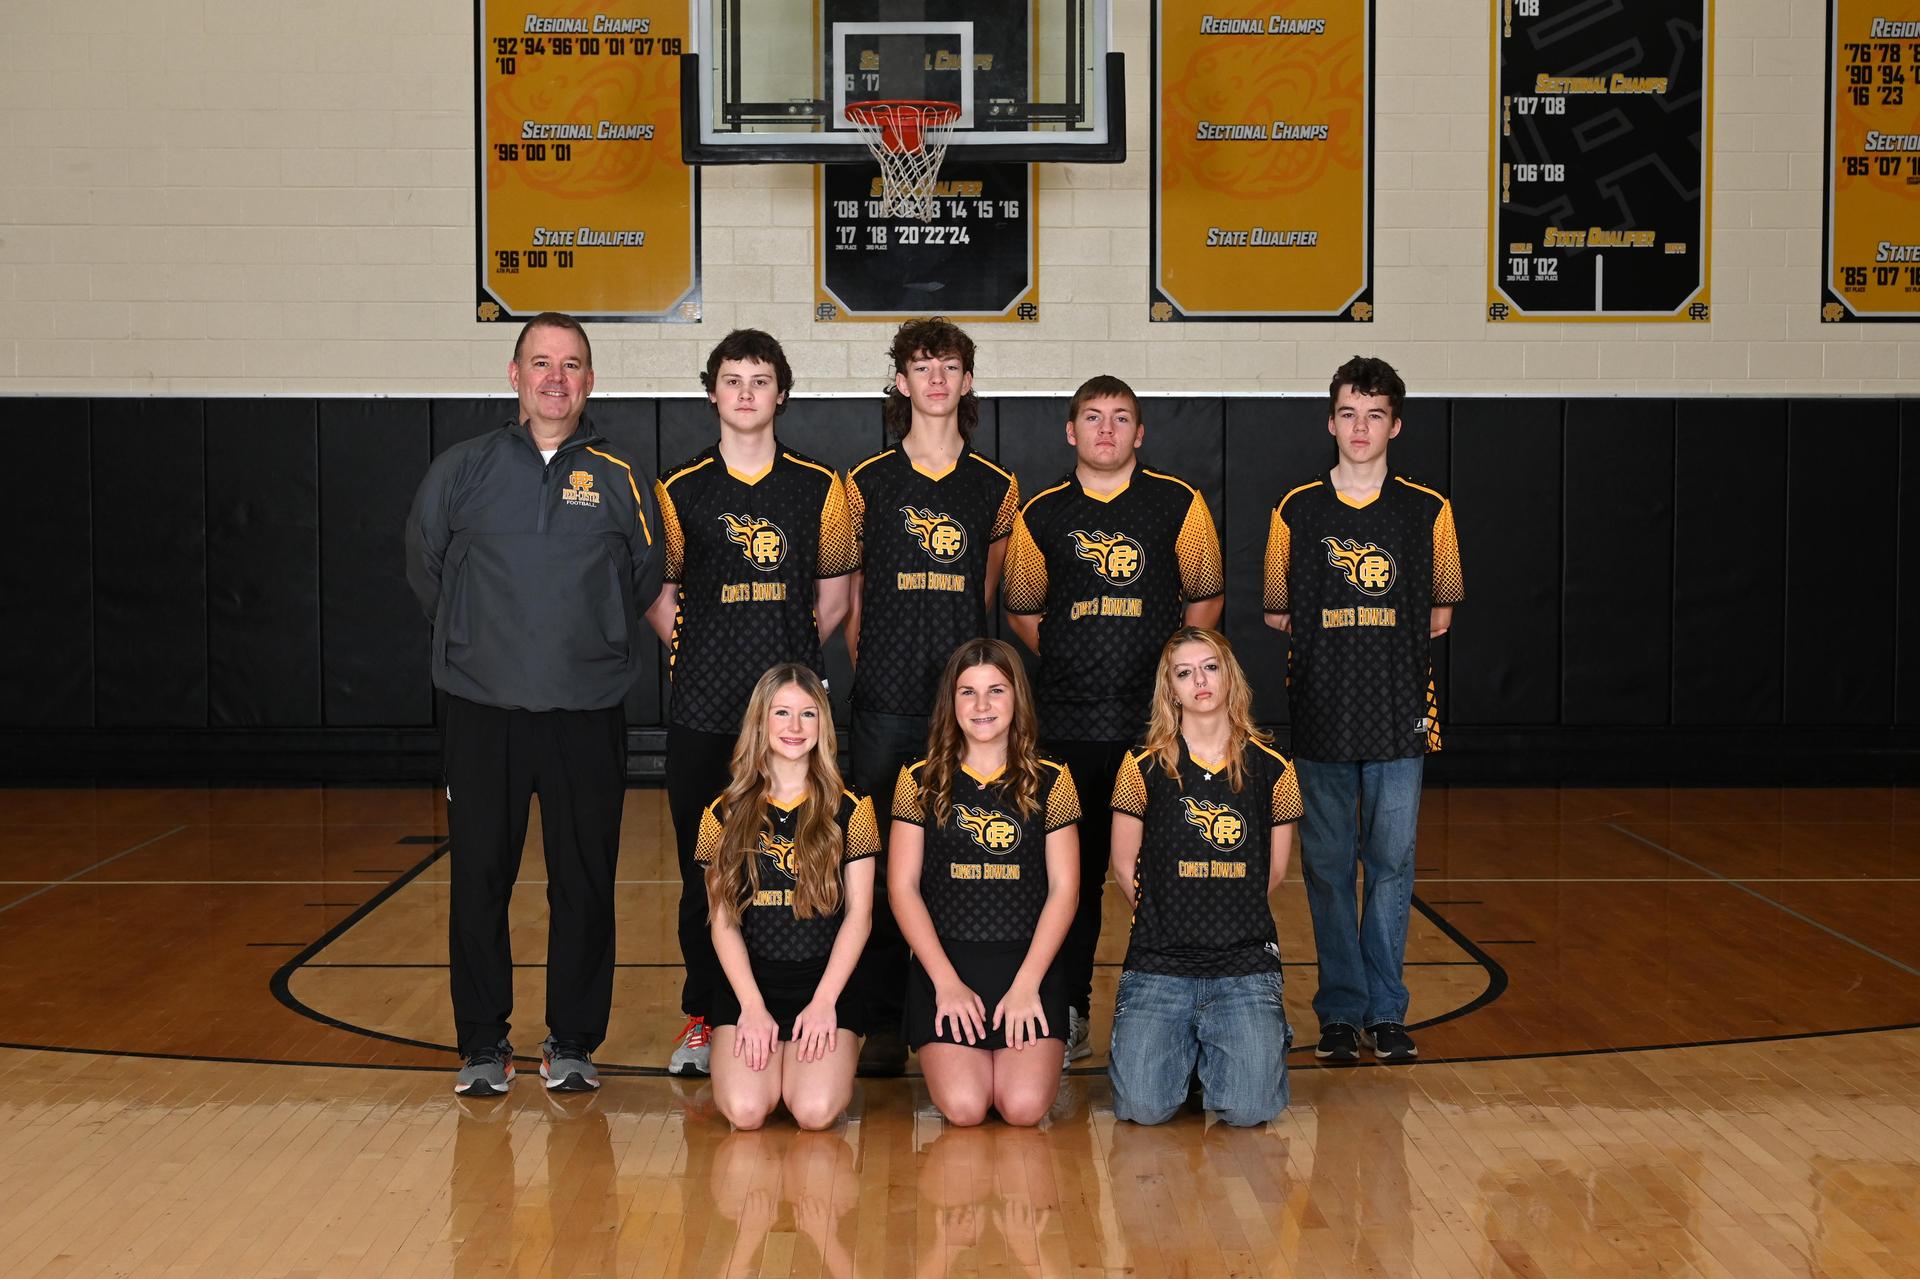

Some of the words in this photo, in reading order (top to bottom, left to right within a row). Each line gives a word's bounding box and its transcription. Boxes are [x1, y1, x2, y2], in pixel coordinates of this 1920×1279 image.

[524, 14, 589, 34] REGIONAL
[592, 14, 651, 34] CHAMPS
[1200, 15, 1264, 34] REGIONAL
[1267, 15, 1326, 34] CHAMPS
[493, 38, 518, 55] '92
[520, 38, 546, 55] '94
[548, 38, 573, 55] '96
[575, 38, 600, 55] '00
[605, 38, 625, 55] '01
[630, 38, 654, 55] '07
[657, 38, 681, 55] '09
[1843, 44, 1871, 63] '76
[1873, 44, 1901, 63] '78
[495, 58, 516, 75] '10
[1845, 65, 1873, 84] '90
[1877, 65, 1905, 84] '94
[1609, 73, 1668, 94] CHAMPS
[1847, 87, 1870, 105] '16
[1877, 87, 1904, 105] '23
[1513, 97, 1538, 115] '07
[1540, 97, 1566, 115] '08
[521, 120, 593, 140] SECTIONAL
[597, 120, 656, 140] CHAMPS
[1196, 121, 1268, 140] SECTIONAL
[1271, 121, 1329, 140] CHAMPS
[1864, 131, 1920, 152] SECTIO
[494, 144, 518, 162] '96
[521, 144, 546, 162] '00
[551, 144, 571, 162] '01
[1513, 164, 1538, 182] '06
[1540, 164, 1565, 182] '08
[1842, 157, 1869, 176] '85
[1874, 157, 1901, 176] '07
[833, 201, 859, 218] '08
[946, 201, 967, 218] '14
[973, 201, 993, 218] '15
[999, 201, 1019, 218] '16
[533, 226, 574, 247] STATE
[576, 226, 645, 247] QUALIFIER
[836, 227, 856, 244] '17
[866, 227, 887, 244] '18
[894, 227, 919, 244] '20
[920, 227, 945, 244] '22
[945, 227, 970, 244] '24
[1206, 226, 1247, 247] STATE
[1250, 226, 1319, 247] QUALIFIER
[1543, 227, 1586, 248] STATE
[495, 251, 519, 268] '96
[523, 251, 547, 268] '00
[553, 251, 573, 268] '01
[1508, 258, 1528, 275] '01
[1533, 258, 1558, 275] '02
[1841, 267, 1867, 286] '85
[1872, 267, 1899, 286] '07
[1322, 607, 1355, 628] COMETS
